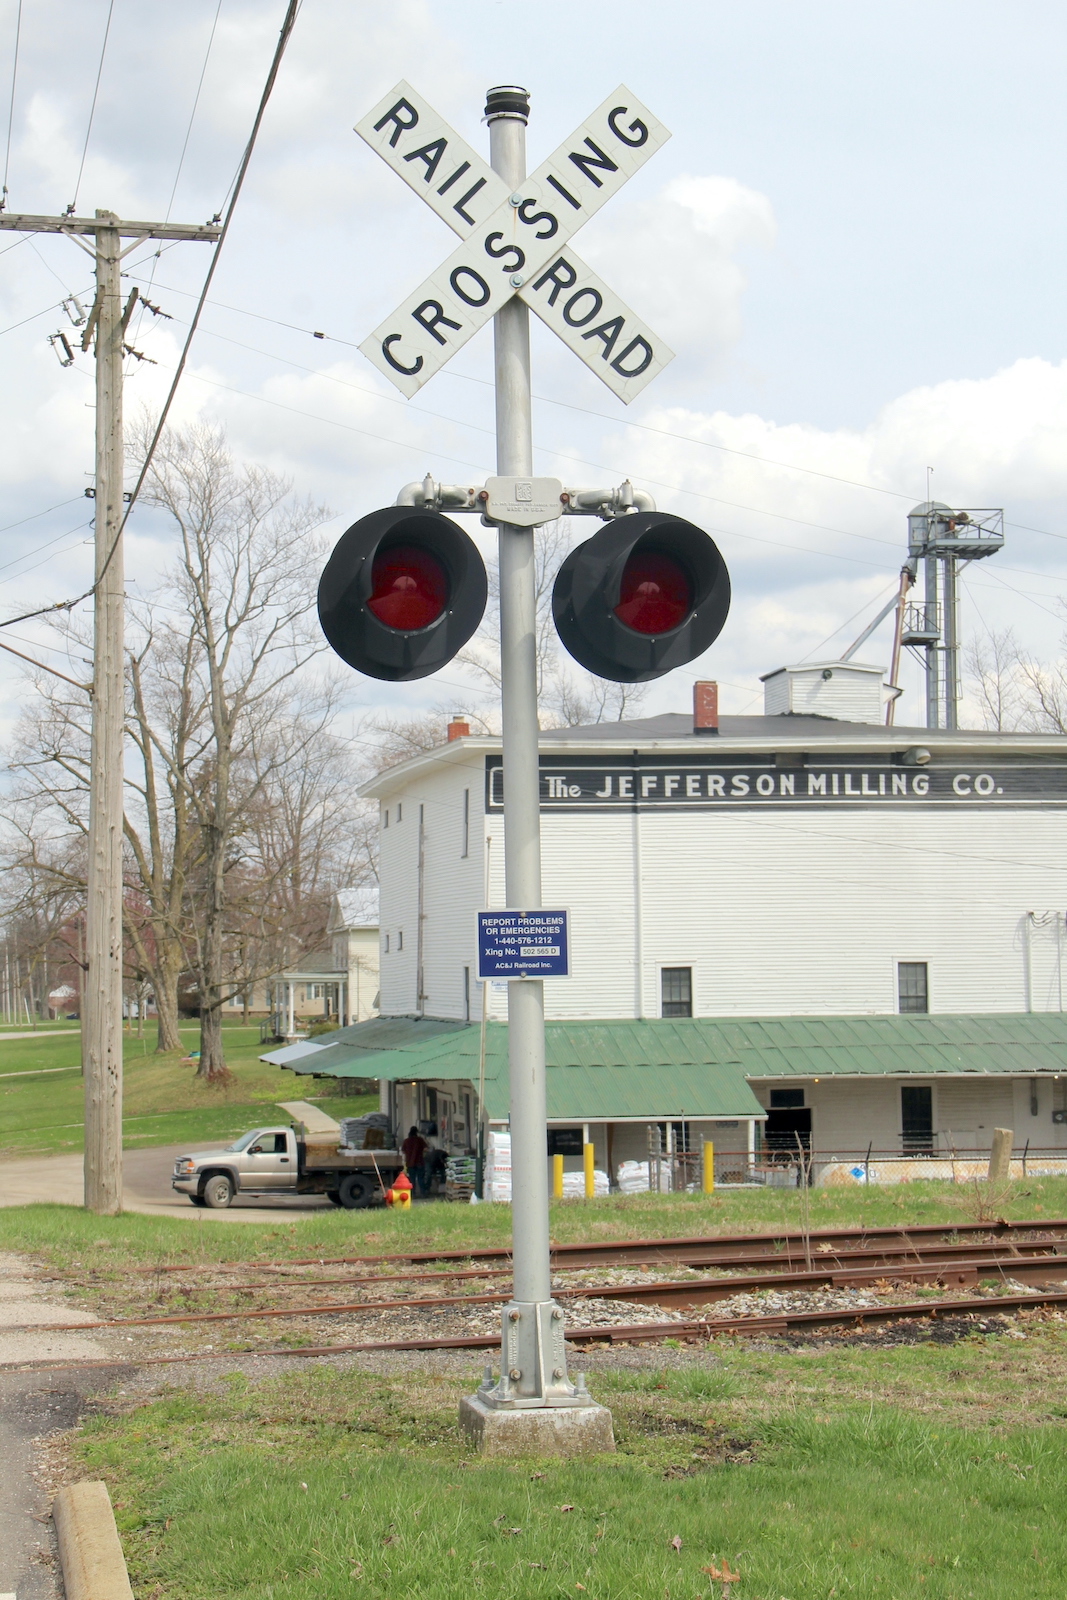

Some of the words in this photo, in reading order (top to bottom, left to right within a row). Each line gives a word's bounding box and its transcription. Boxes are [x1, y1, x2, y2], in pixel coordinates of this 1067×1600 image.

[373, 97, 487, 226] RAIL
[381, 106, 649, 376] CROSSING
[532, 256, 653, 378] ROAD
[545, 776, 582, 798] The
[595, 774, 795, 798] JEFFERSON
[807, 773, 930, 796] MILLING
[952, 773, 1004, 796] CO.
[482, 918, 516, 926] REPORT
[518, 917, 564, 925] PROBLEMS
[500, 926, 560, 935] EMERGENCIES
[485, 948, 503, 957] Xing
